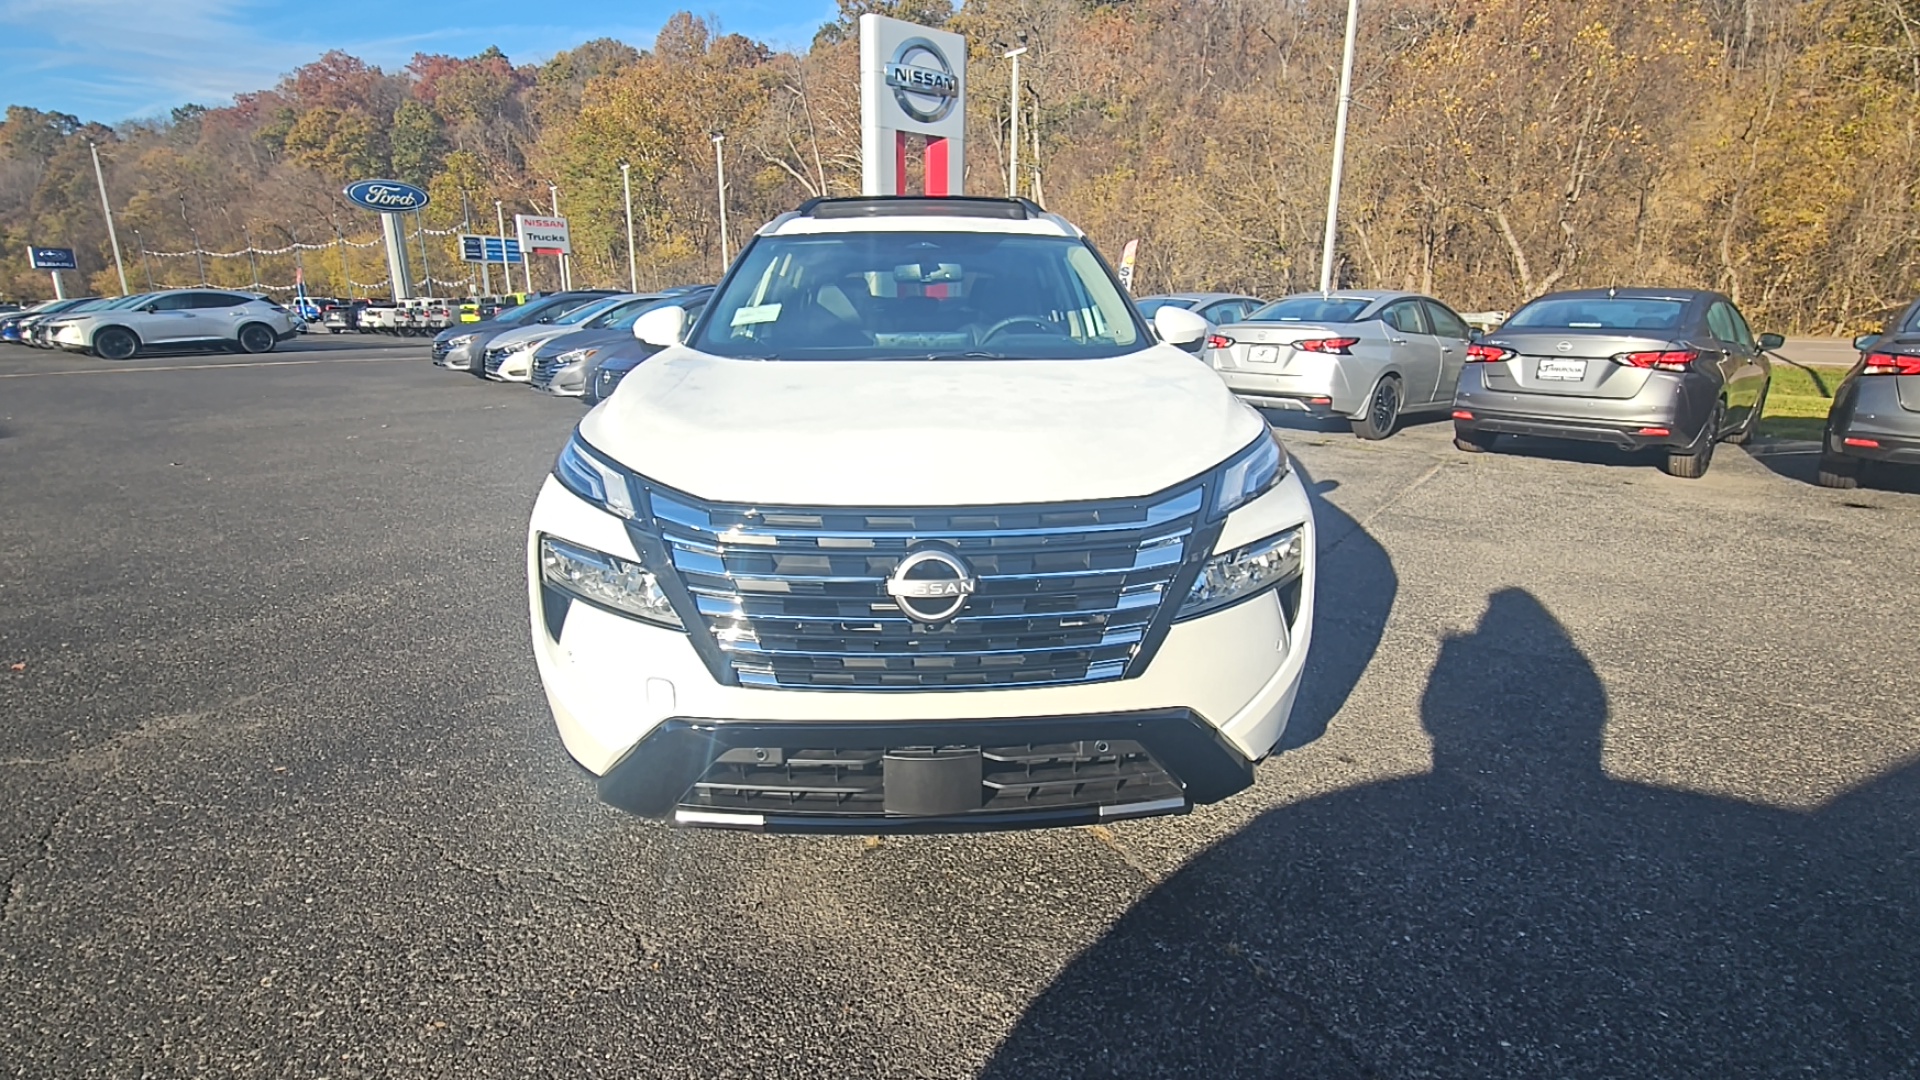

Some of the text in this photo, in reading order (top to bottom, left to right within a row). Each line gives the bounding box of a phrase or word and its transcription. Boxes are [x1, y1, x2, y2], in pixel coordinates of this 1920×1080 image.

[894, 67, 956, 92] NISSAN
[365, 184, 416, 206] Ford
[523, 218, 565, 229] NISSAN
[526, 232, 566, 242] Trucks
[891, 580, 975, 596] SSAN
